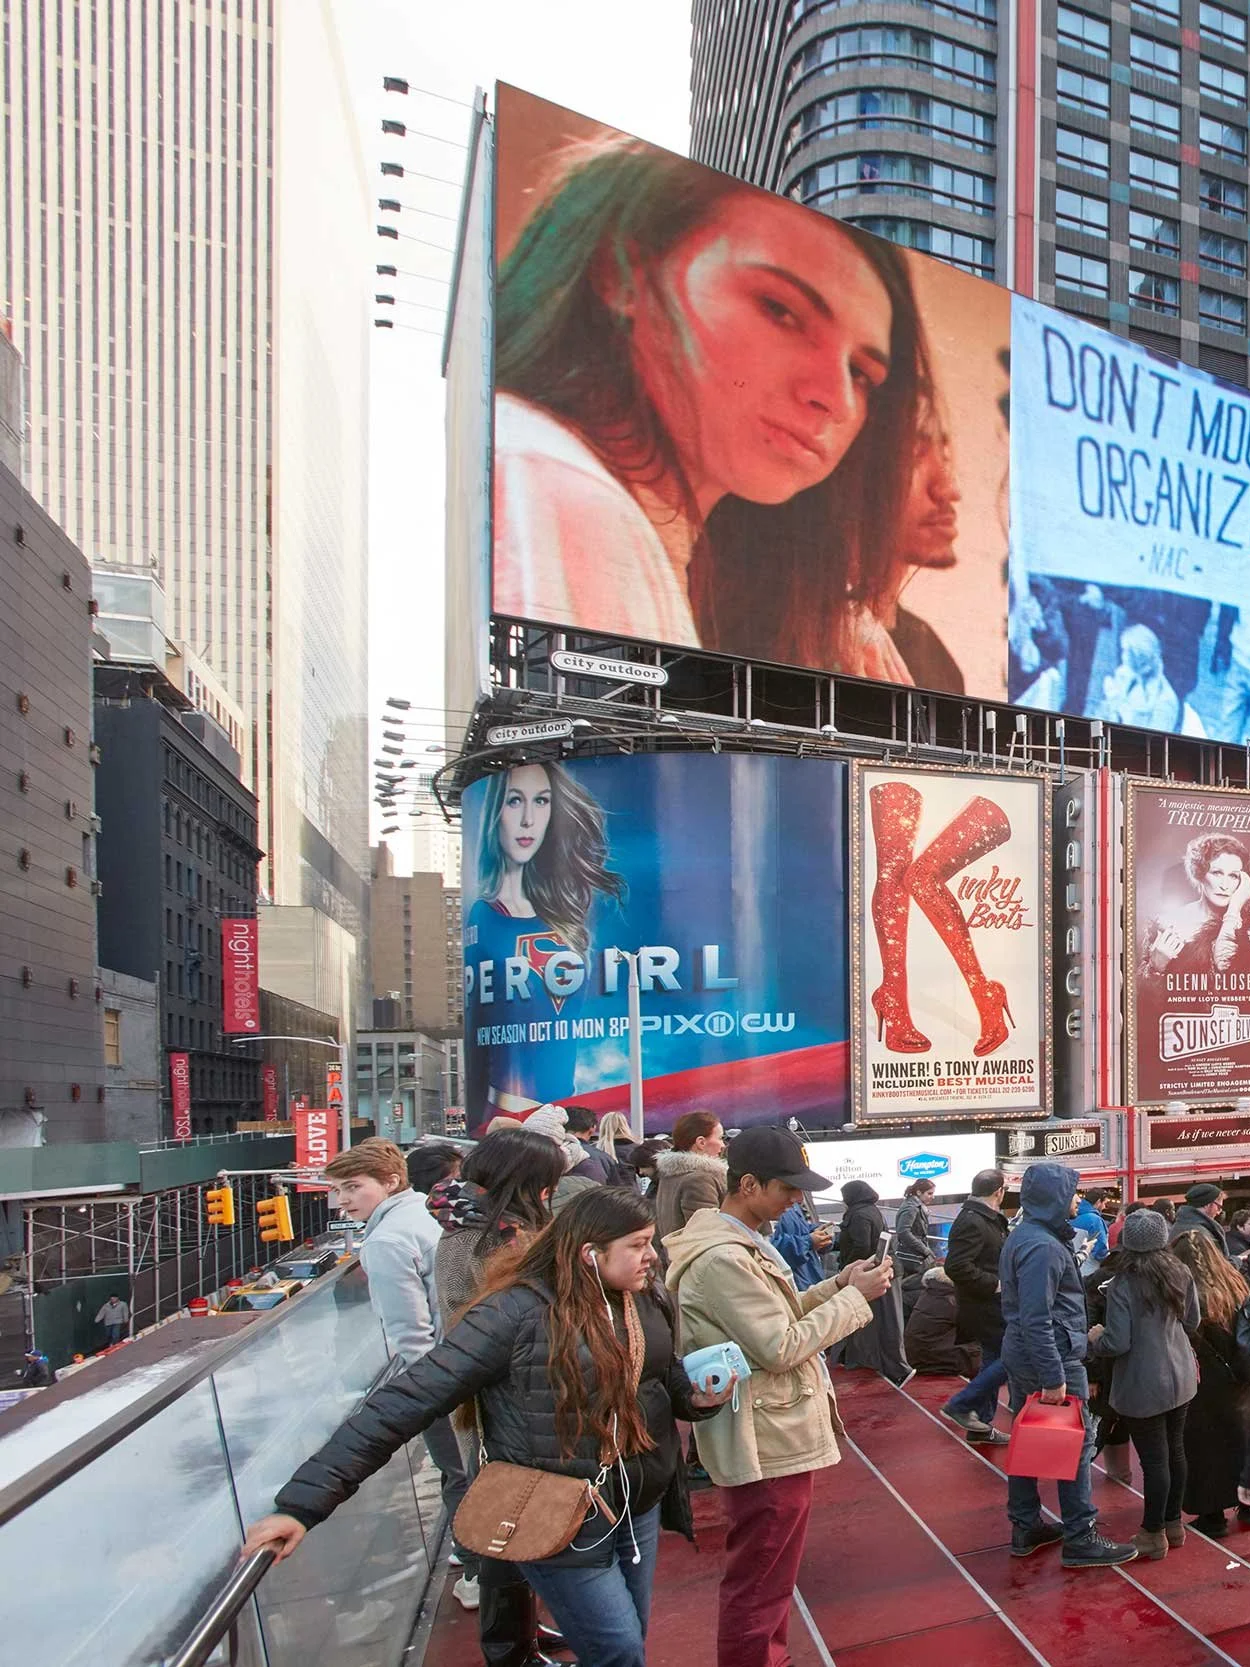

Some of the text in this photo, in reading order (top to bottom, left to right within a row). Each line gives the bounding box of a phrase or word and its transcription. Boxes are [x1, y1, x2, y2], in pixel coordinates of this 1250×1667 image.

[563, 656, 659, 680] city outdoor
[495, 721, 567, 740] city outdoor
[966, 904, 1034, 931] Boots
[228, 923, 256, 1021] nighthotels
[1166, 973, 1208, 991] GLENN
[477, 1026, 491, 1046] NEW
[491, 1023, 527, 1045] SEASON
[529, 1021, 553, 1042] OCT
[555, 1020, 568, 1041] 10
[572, 1018, 605, 1040] MON
[1172, 1019, 1231, 1053] SUNSET
[872, 1059, 1034, 1079] WINNER! 6 TONY AWARDS
[872, 1075, 1035, 1089] INCLUDING BEST MUSICAL
[1159, 1082, 1189, 1090] STRICTLY
[1190, 1080, 1216, 1088] LIMITED
[308, 1112, 328, 1164] LOVE
[1051, 1135, 1082, 1153] SUNSET
[1177, 1129, 1191, 1140] As
[1191, 1128, 1202, 1142] if
[1201, 1130, 1215, 1139] we
[1215, 1129, 1241, 1137] never
[900, 1158, 949, 1173] Hampton
